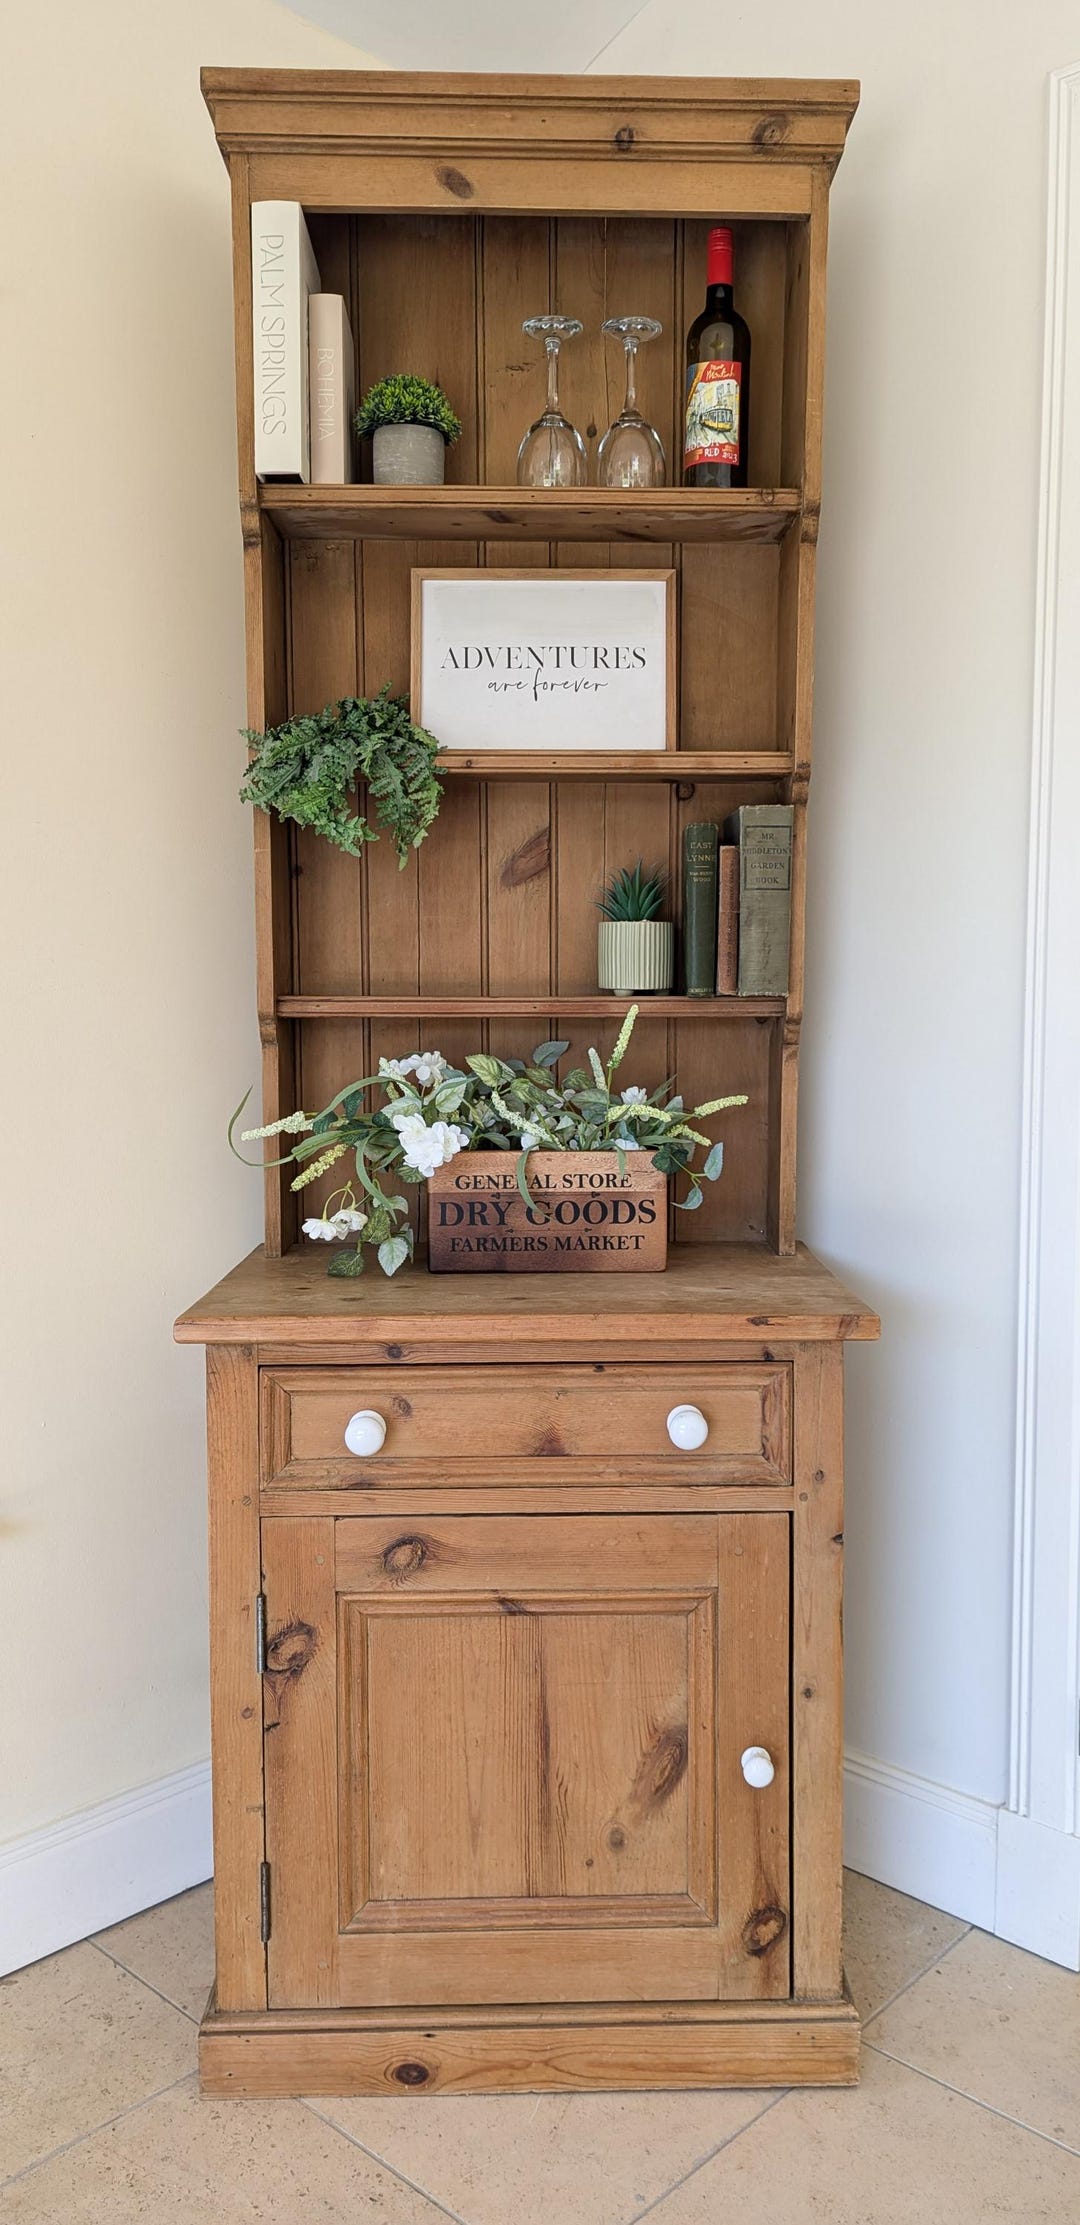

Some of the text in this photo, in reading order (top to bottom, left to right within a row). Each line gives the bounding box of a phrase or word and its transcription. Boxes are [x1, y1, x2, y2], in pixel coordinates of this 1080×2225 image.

[259, 234, 287, 436] PALM SPRINGS
[317, 348, 336, 440] BOHEMIA
[440, 646, 646, 669] ADVENTURES
[488, 667, 609, 702] are forever
[690, 841, 713, 849] EAST
[750, 862, 785, 870] GARDEN
[562, 1173, 633, 1189] STORE
[437, 1199, 657, 1227] DRY GOODS
[450, 1234, 646, 1253] FARMERS MARKET
